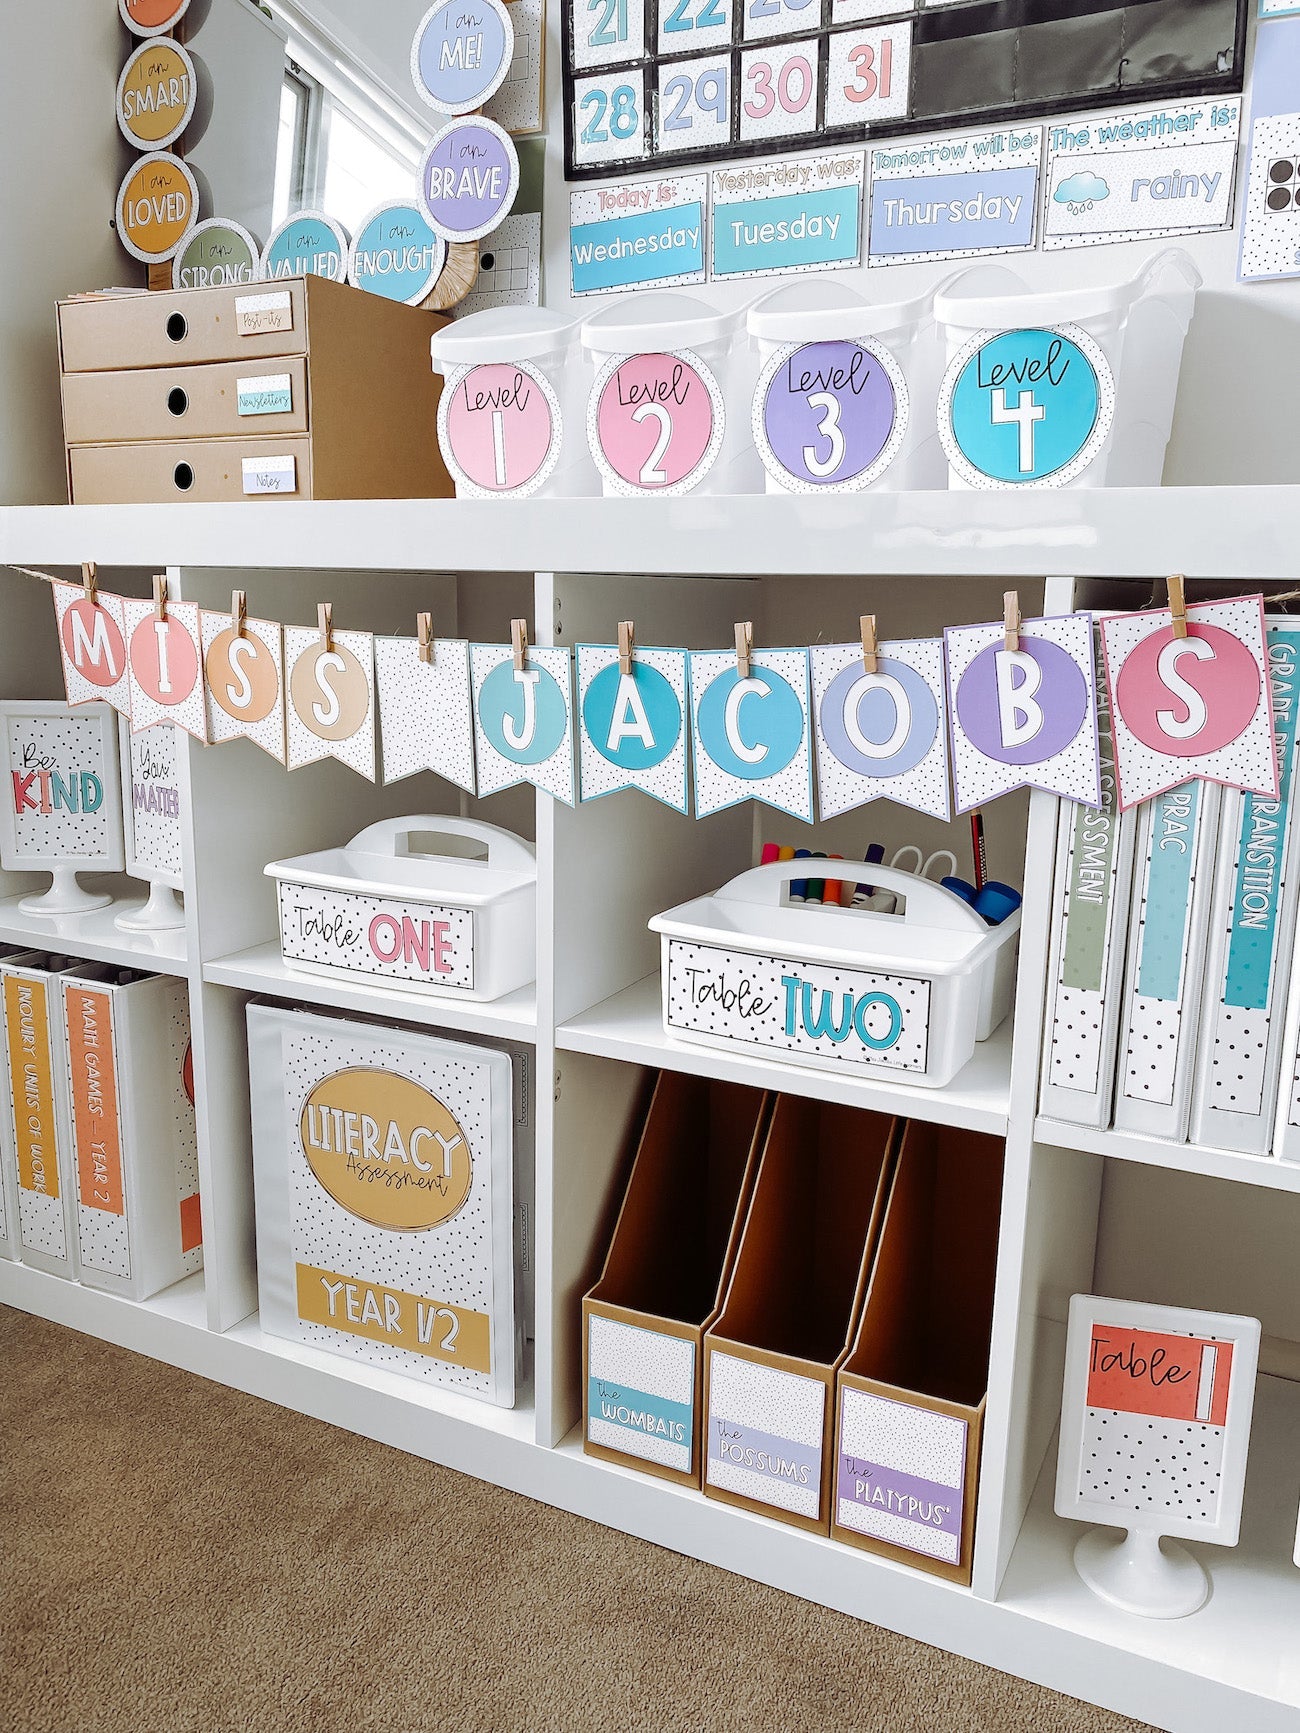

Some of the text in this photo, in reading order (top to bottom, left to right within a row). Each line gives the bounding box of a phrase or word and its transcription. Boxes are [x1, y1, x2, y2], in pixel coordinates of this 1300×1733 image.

[456, 14, 484, 29] am
[586, 0, 628, 47] 21
[664, 0, 726, 33] 22
[148, 63, 170, 77] am
[439, 32, 484, 71] ME!
[843, 39, 893, 103] 31
[123, 74, 189, 121] SMART
[664, 67, 727, 132] 29
[744, 56, 813, 119] 30
[580, 85, 639, 144] 28
[1051, 106, 1237, 151] The weather is:
[460, 144, 488, 162] am
[873, 132, 1038, 171] Tomorrow will be:
[151, 175, 173, 190] am
[429, 166, 502, 201] BRAVE
[716, 159, 861, 192] Yesterday was:
[1131, 169, 1223, 203] rainy
[127, 191, 187, 229] LOVED
[598, 183, 678, 213] Today is:
[883, 191, 1023, 228] Thursday
[296, 234, 321, 249] am
[389, 223, 415, 239] am
[574, 226, 700, 265] Wednesday
[731, 212, 841, 248] Tuesday
[210, 244, 233, 257] am
[267, 251, 340, 281] VALUED
[354, 243, 439, 278] ENOUGH
[180, 261, 252, 288] STRONG
[788, 351, 870, 394] Level
[978, 339, 1070, 388] Level
[239, 392, 292, 409] Newsletters
[464, 373, 530, 411] Level
[617, 364, 691, 406] Level
[491, 410, 507, 486] 1
[631, 401, 673, 484] 2
[802, 390, 845, 478] 3
[990, 387, 1045, 473] 4
[256, 473, 281, 489] Notes
[70, 608, 347, 727] MISS
[501, 636, 1217, 764] JACOBS
[22, 742, 57, 771] Be
[139, 744, 170, 781] You
[11, 770, 104, 815] KIND
[133, 783, 180, 820] MATTER
[1158, 792, 1193, 855] PRAC
[293, 905, 453, 974] Table ONE
[80, 996, 100, 1047] MATH
[684, 967, 904, 1051] Table TWO
[17, 985, 47, 1194] INQUIRY UNITS OF WORK
[84, 1051, 105, 1118] GAMES
[306, 1104, 464, 1178] LITERACY
[91, 1141, 109, 1185] YEAR
[346, 1152, 449, 1198] Assessment
[93, 1189, 111, 1204] 2
[319, 1275, 404, 1336] YEAR
[596, 1381, 622, 1401] the
[1091, 1337, 1218, 1422] Table 1
[600, 1400, 687, 1443] WOMBATS
[716, 1420, 744, 1441] the
[720, 1439, 812, 1486] POSSUMS
[844, 1457, 874, 1480] the
[854, 1478, 952, 1527] PLATYPUS'
